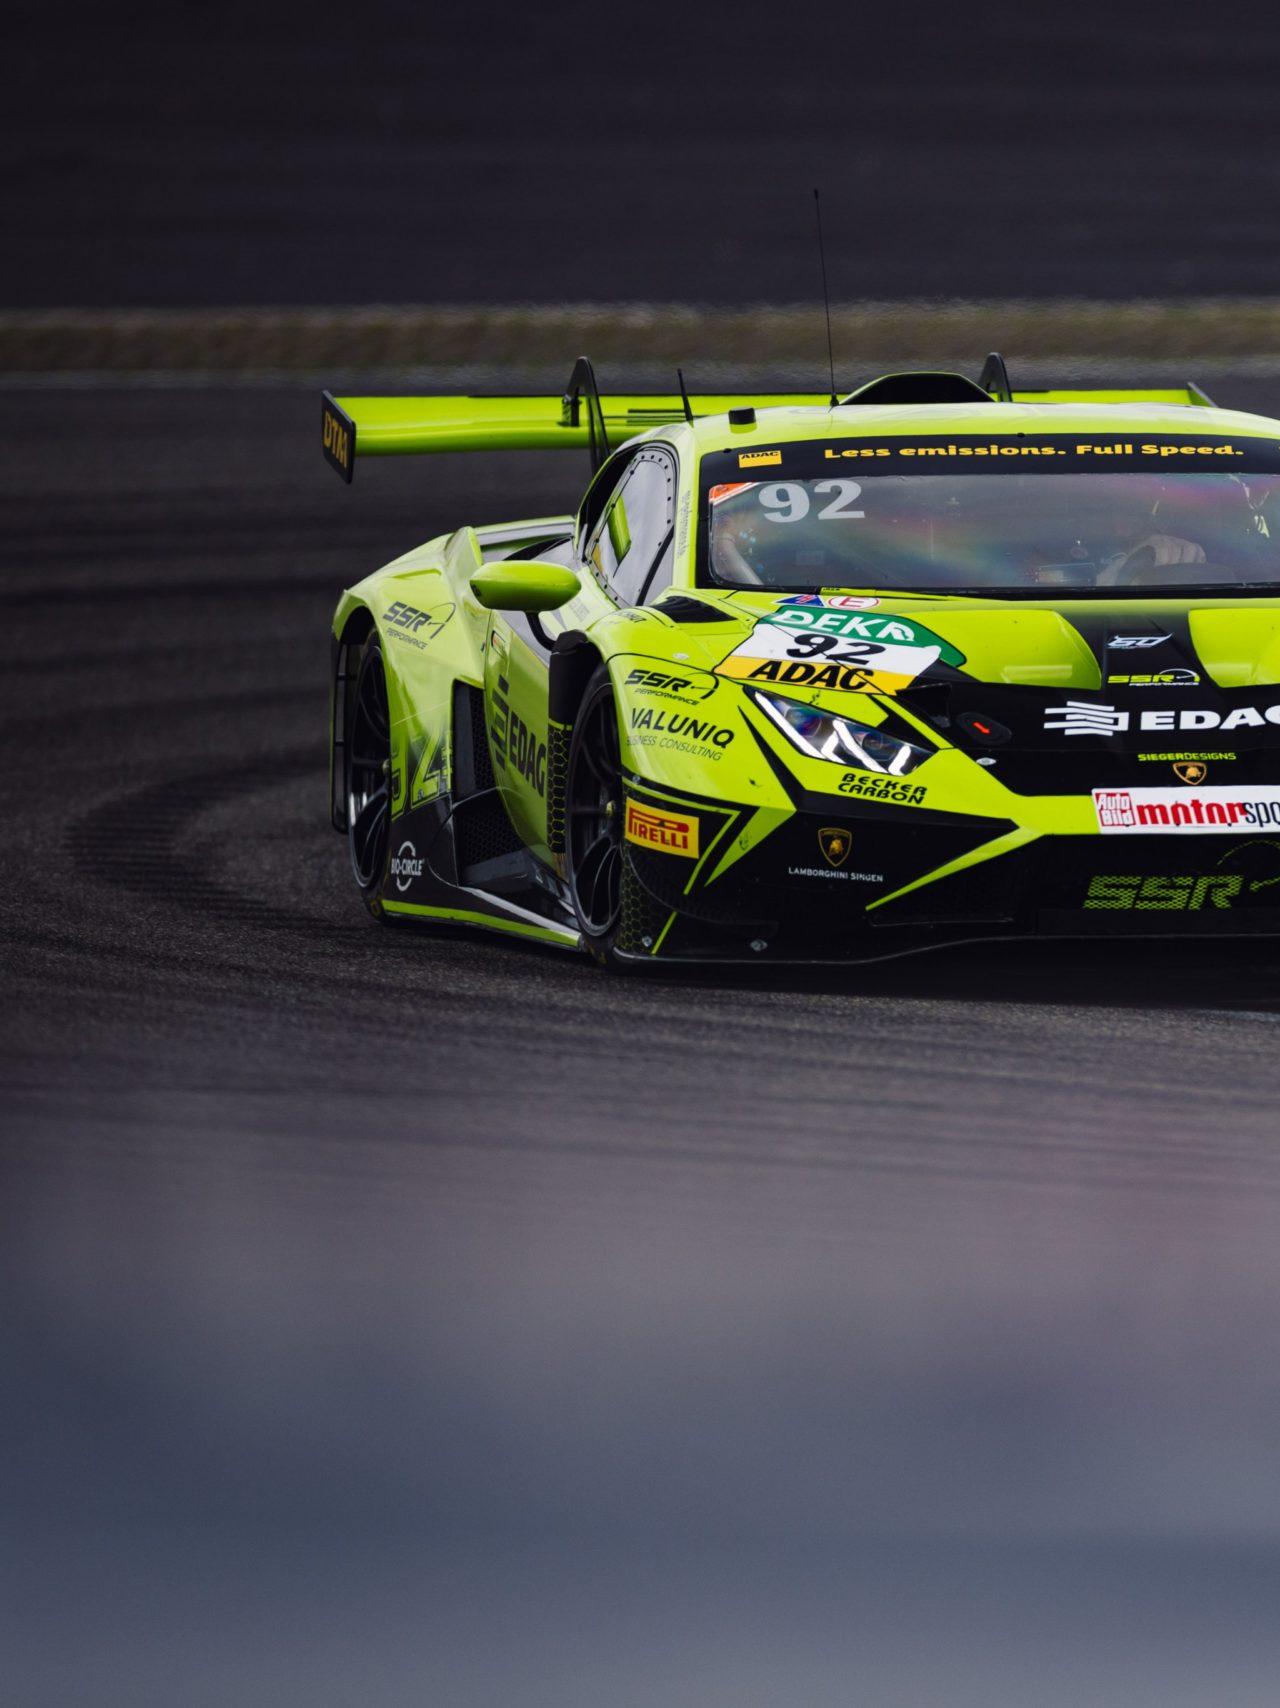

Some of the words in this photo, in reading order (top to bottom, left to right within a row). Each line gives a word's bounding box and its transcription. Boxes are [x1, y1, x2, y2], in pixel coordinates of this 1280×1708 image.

[324, 410, 348, 469] DTM
[824, 448, 891, 459] Less
[899, 444, 1067, 457] emissions.
[1076, 444, 1133, 455] Full
[1141, 444, 1245, 457] Speed.
[741, 451, 780, 459] ADAC
[758, 479, 866, 523] 92
[382, 601, 432, 632] SSR
[786, 633, 887, 666] 92
[624, 669, 693, 692] SSR
[748, 660, 875, 691] ADAC
[1107, 674, 1175, 684] SSR
[634, 688, 701, 706] PERFORMANCE
[630, 707, 735, 749] VALUNIQ
[509, 710, 547, 798] EDAG
[660, 737, 723, 761] CONSULTING
[1137, 752, 1237, 762] SIEGERDESIGNS
[838, 782, 925, 805] CARBON
[841, 772, 928, 796] BECKER
[628, 806, 690, 850] PIRELLI
[788, 866, 849, 879] LAMBORGHINI
[850, 872, 883, 882] SINGEN
[1083, 875, 1245, 910] SSR
